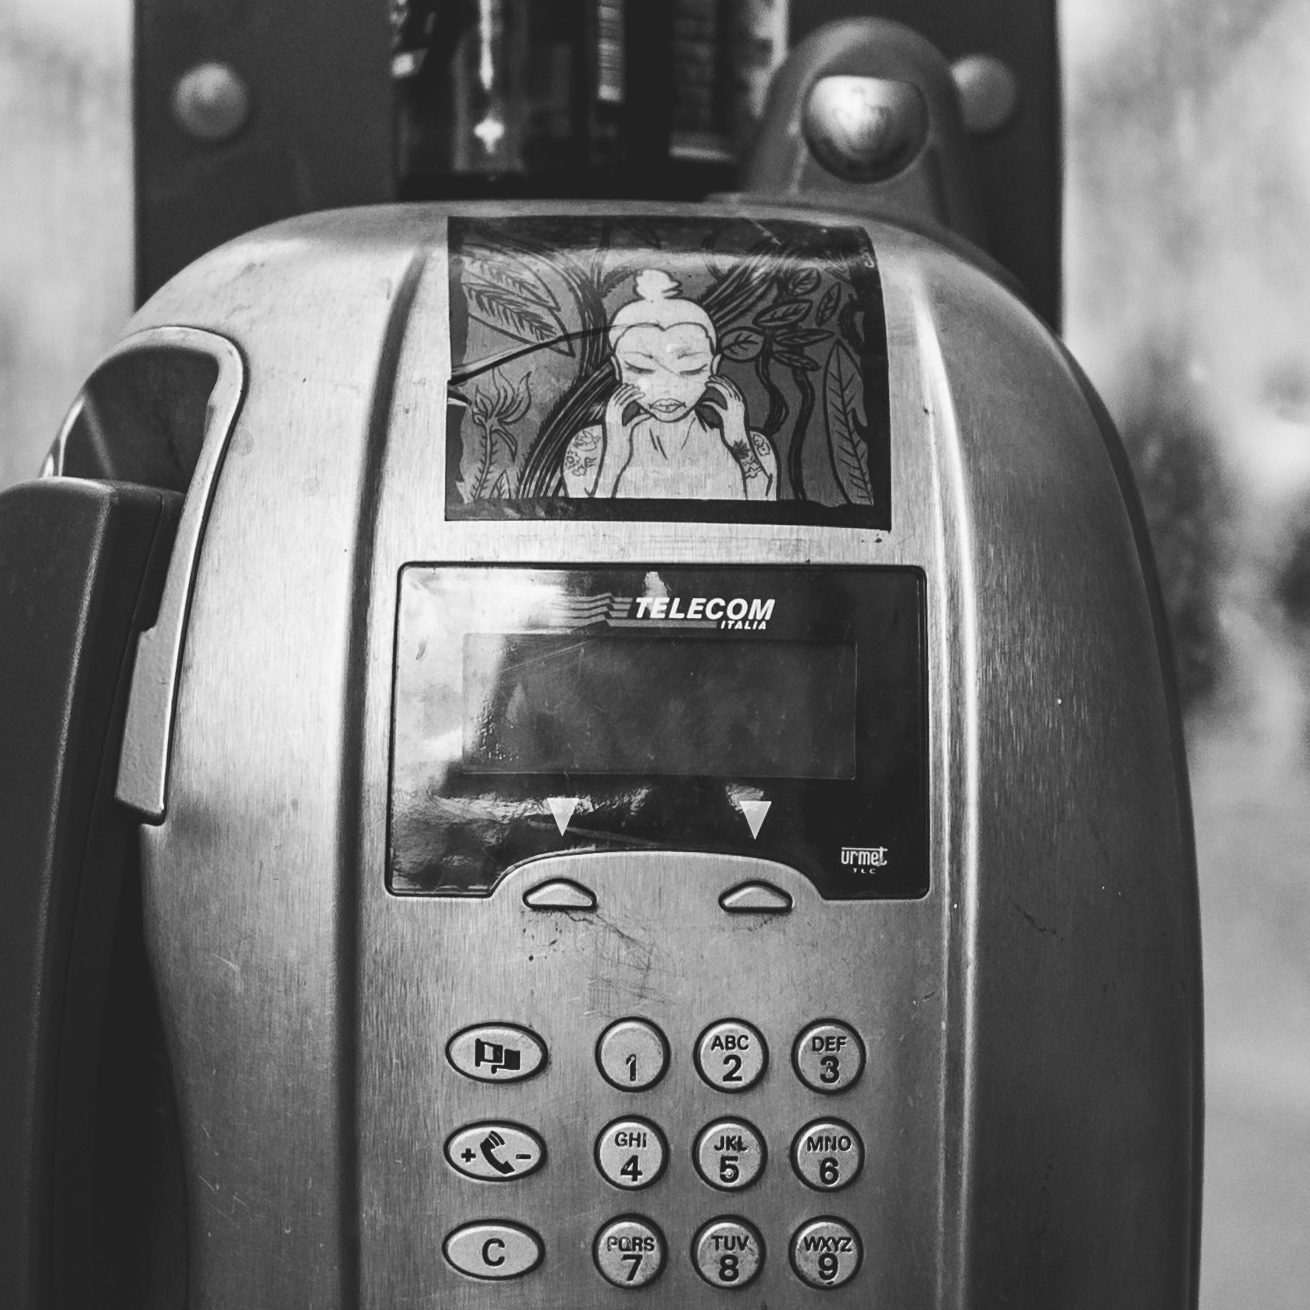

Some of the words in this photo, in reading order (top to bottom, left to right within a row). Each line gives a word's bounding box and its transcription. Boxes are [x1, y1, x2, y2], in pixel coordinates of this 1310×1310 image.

[635, 597, 776, 621] TELECOM
[720, 620, 767, 630] ITALIA
[710, 1034, 750, 1052] ABC
[811, 1035, 848, 1053] DEF
[625, 1053, 637, 1082] 1
[722, 1054, 743, 1083] 2
[819, 1055, 840, 1084] 3
[614, 1131, 648, 1149] GHI
[713, 1134, 749, 1153] JKL
[806, 1134, 852, 1153] MNO
[620, 1155, 643, 1183] 4
[719, 1154, 740, 1184] 5
[819, 1156, 840, 1186] 6
[481, 1237, 506, 1267] C
[606, 1235, 655, 1253] PQRS
[711, 1234, 749, 1252] TUV
[803, 1234, 852, 1254] WXYZ
[621, 1253, 643, 1283] 7
[718, 1253, 739, 1283] 8
[817, 1253, 838, 1282] 9
